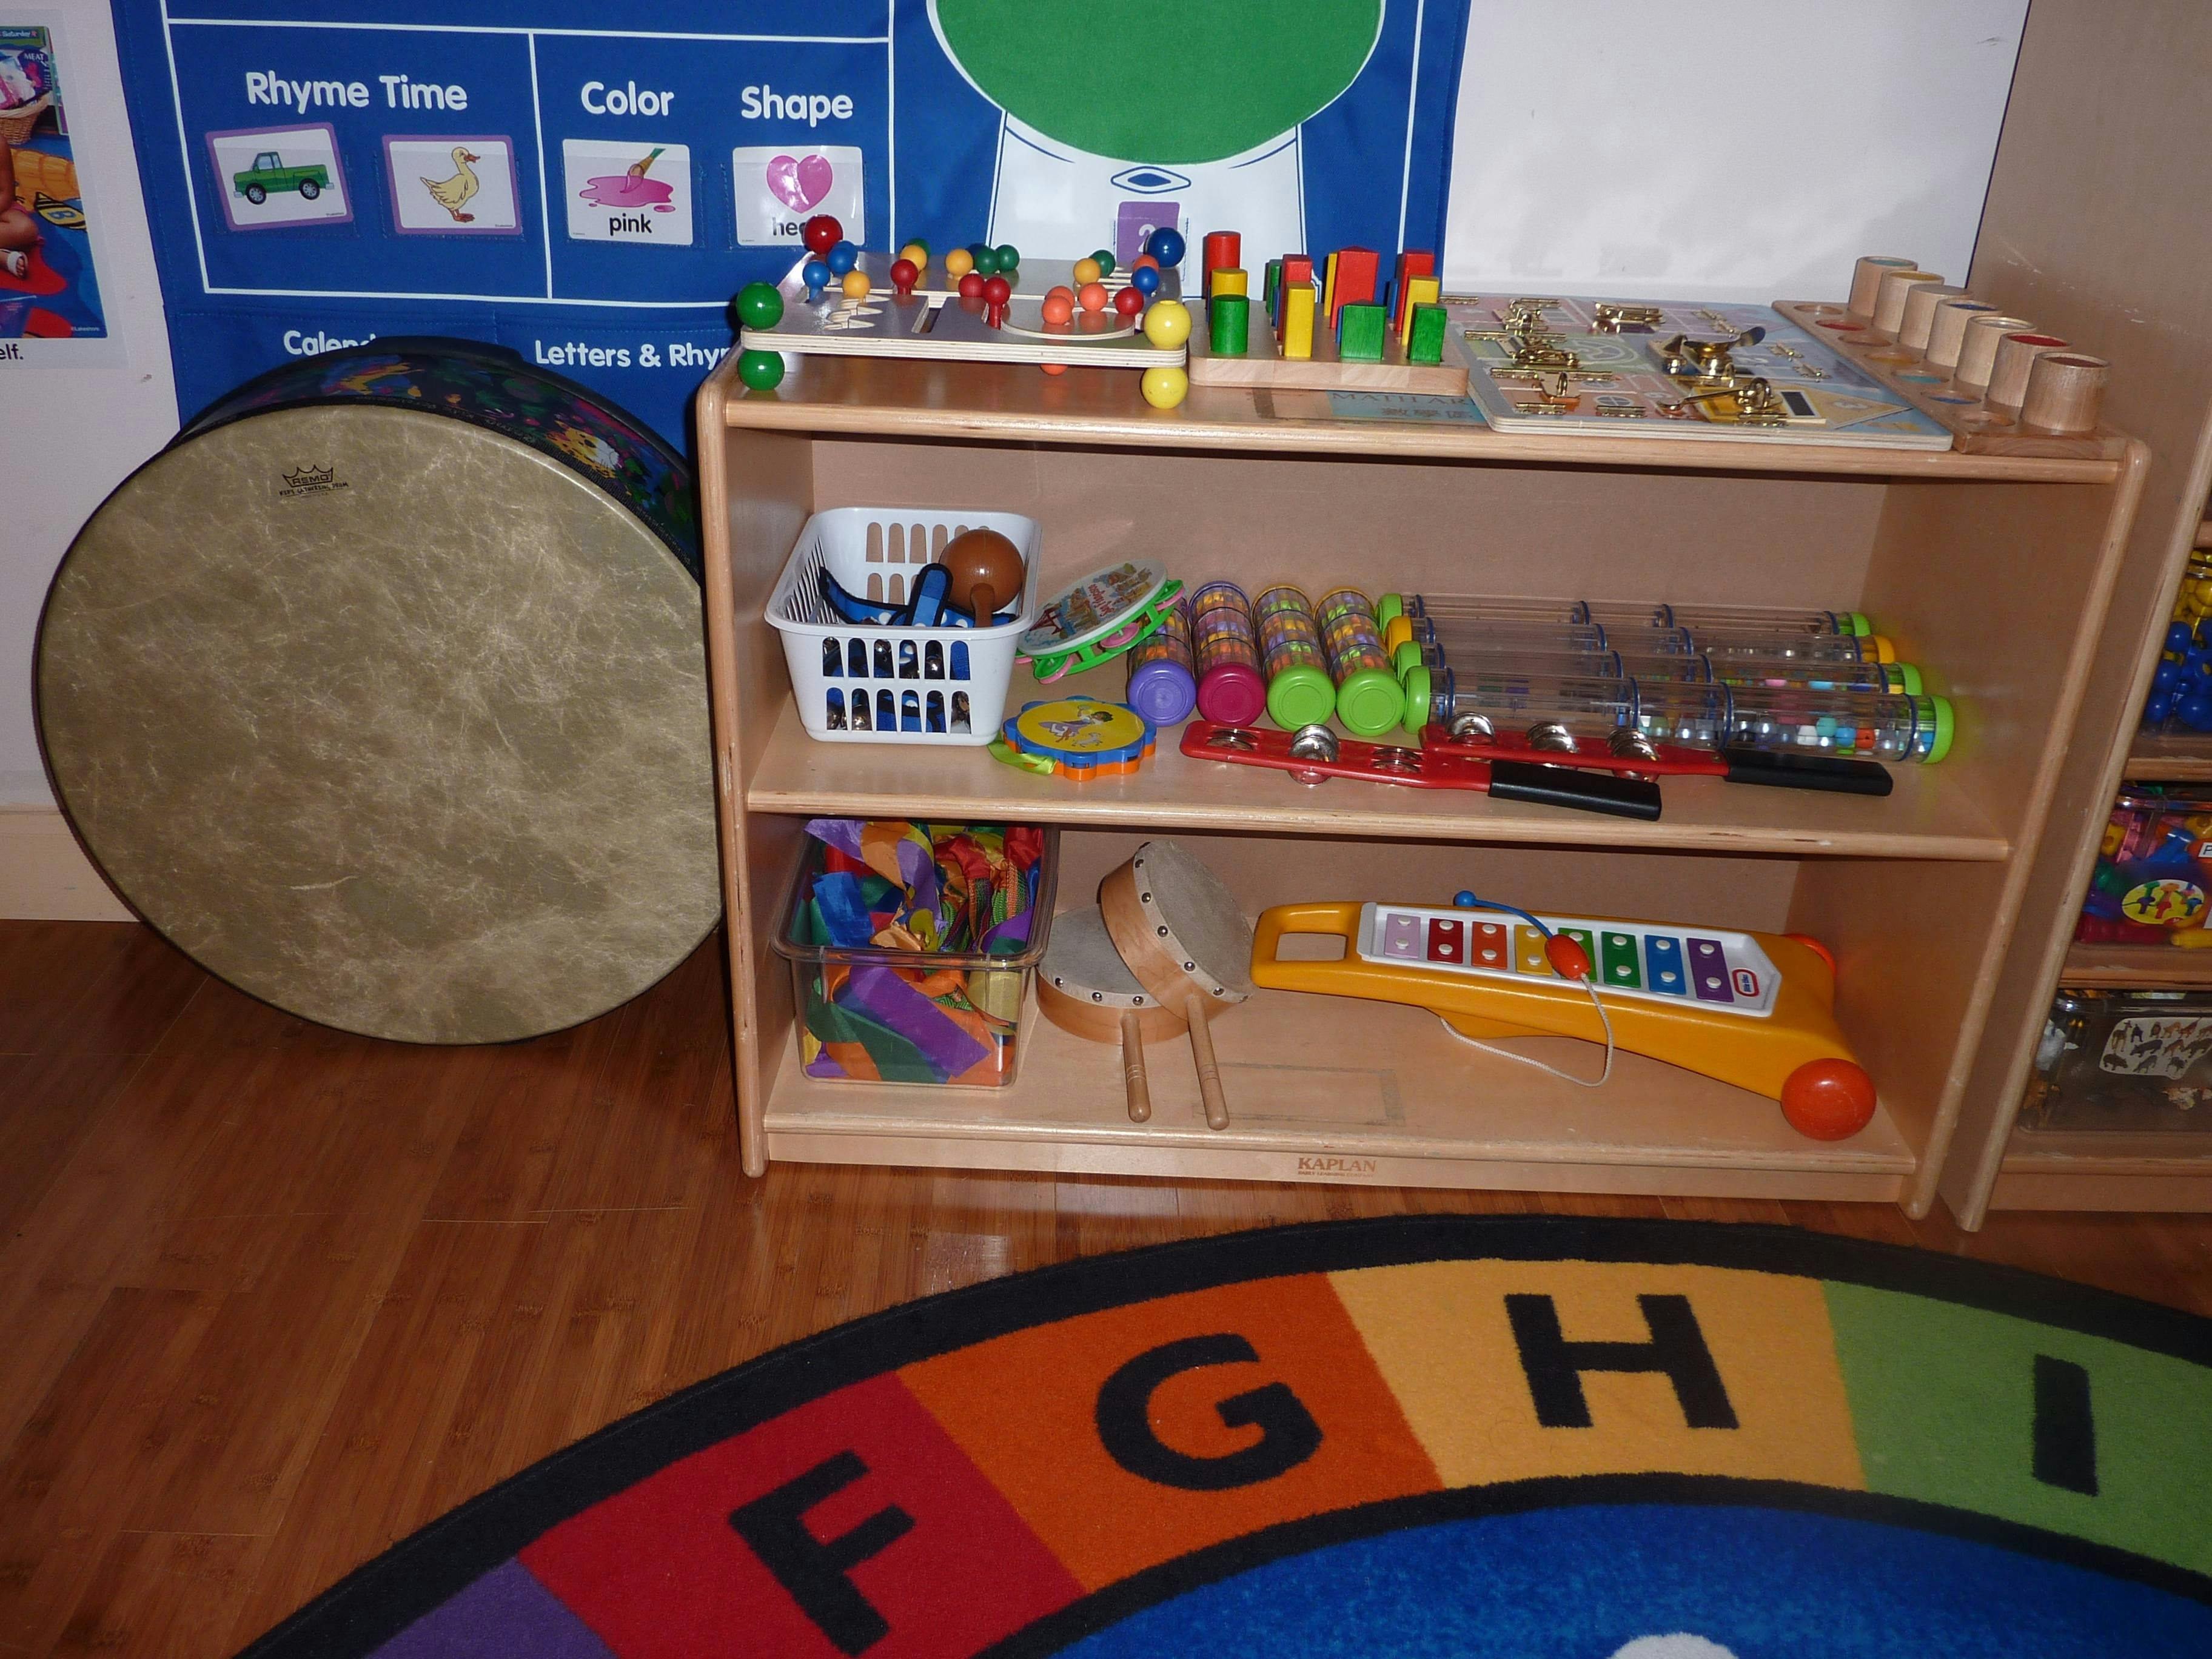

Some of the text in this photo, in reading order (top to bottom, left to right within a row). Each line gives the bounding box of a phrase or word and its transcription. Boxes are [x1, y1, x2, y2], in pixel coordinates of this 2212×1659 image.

[246, 70, 468, 115] Rhyme Time
[581, 80, 674, 116] Color
[742, 84, 853, 128] Shape
[609, 213, 652, 236] pink
[535, 340, 631, 367] Letters
[639, 344, 662, 367] &
[292, 474, 329, 485] REMO
[1298, 1157, 1376, 1172] KAPLAN
[729, 1293, 2099, 1657] F G H I
